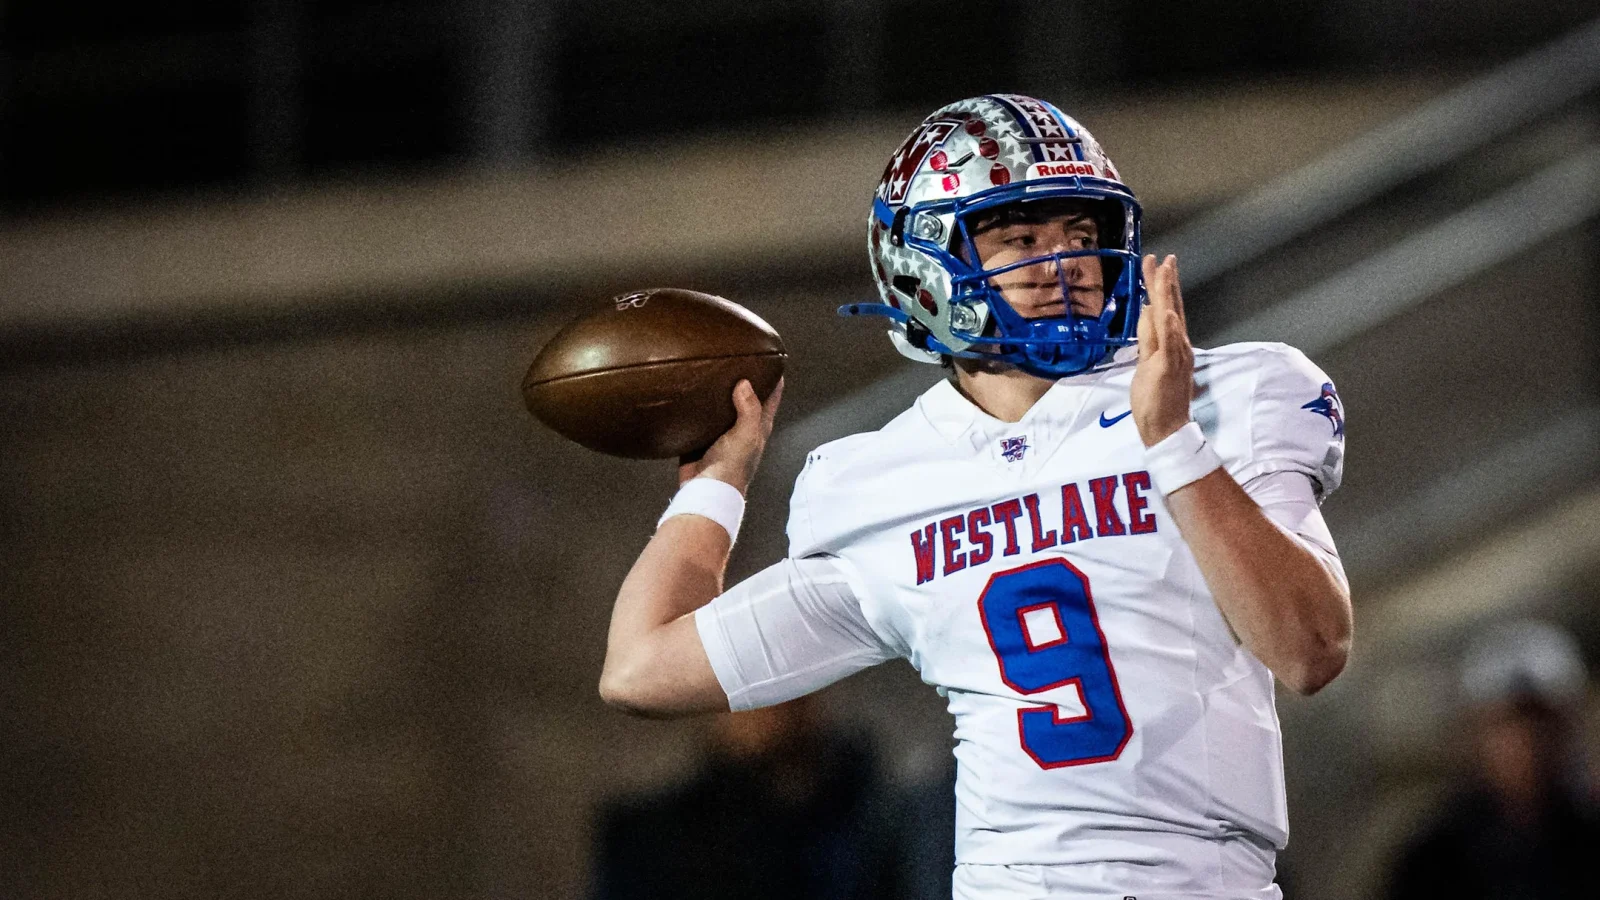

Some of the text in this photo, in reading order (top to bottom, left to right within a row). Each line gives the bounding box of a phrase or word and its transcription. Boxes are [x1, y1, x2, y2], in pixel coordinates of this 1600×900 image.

[1036, 163, 1095, 176] Riddell
[910, 470, 1158, 586] WESTLAKE
[977, 556, 1134, 770] 9
